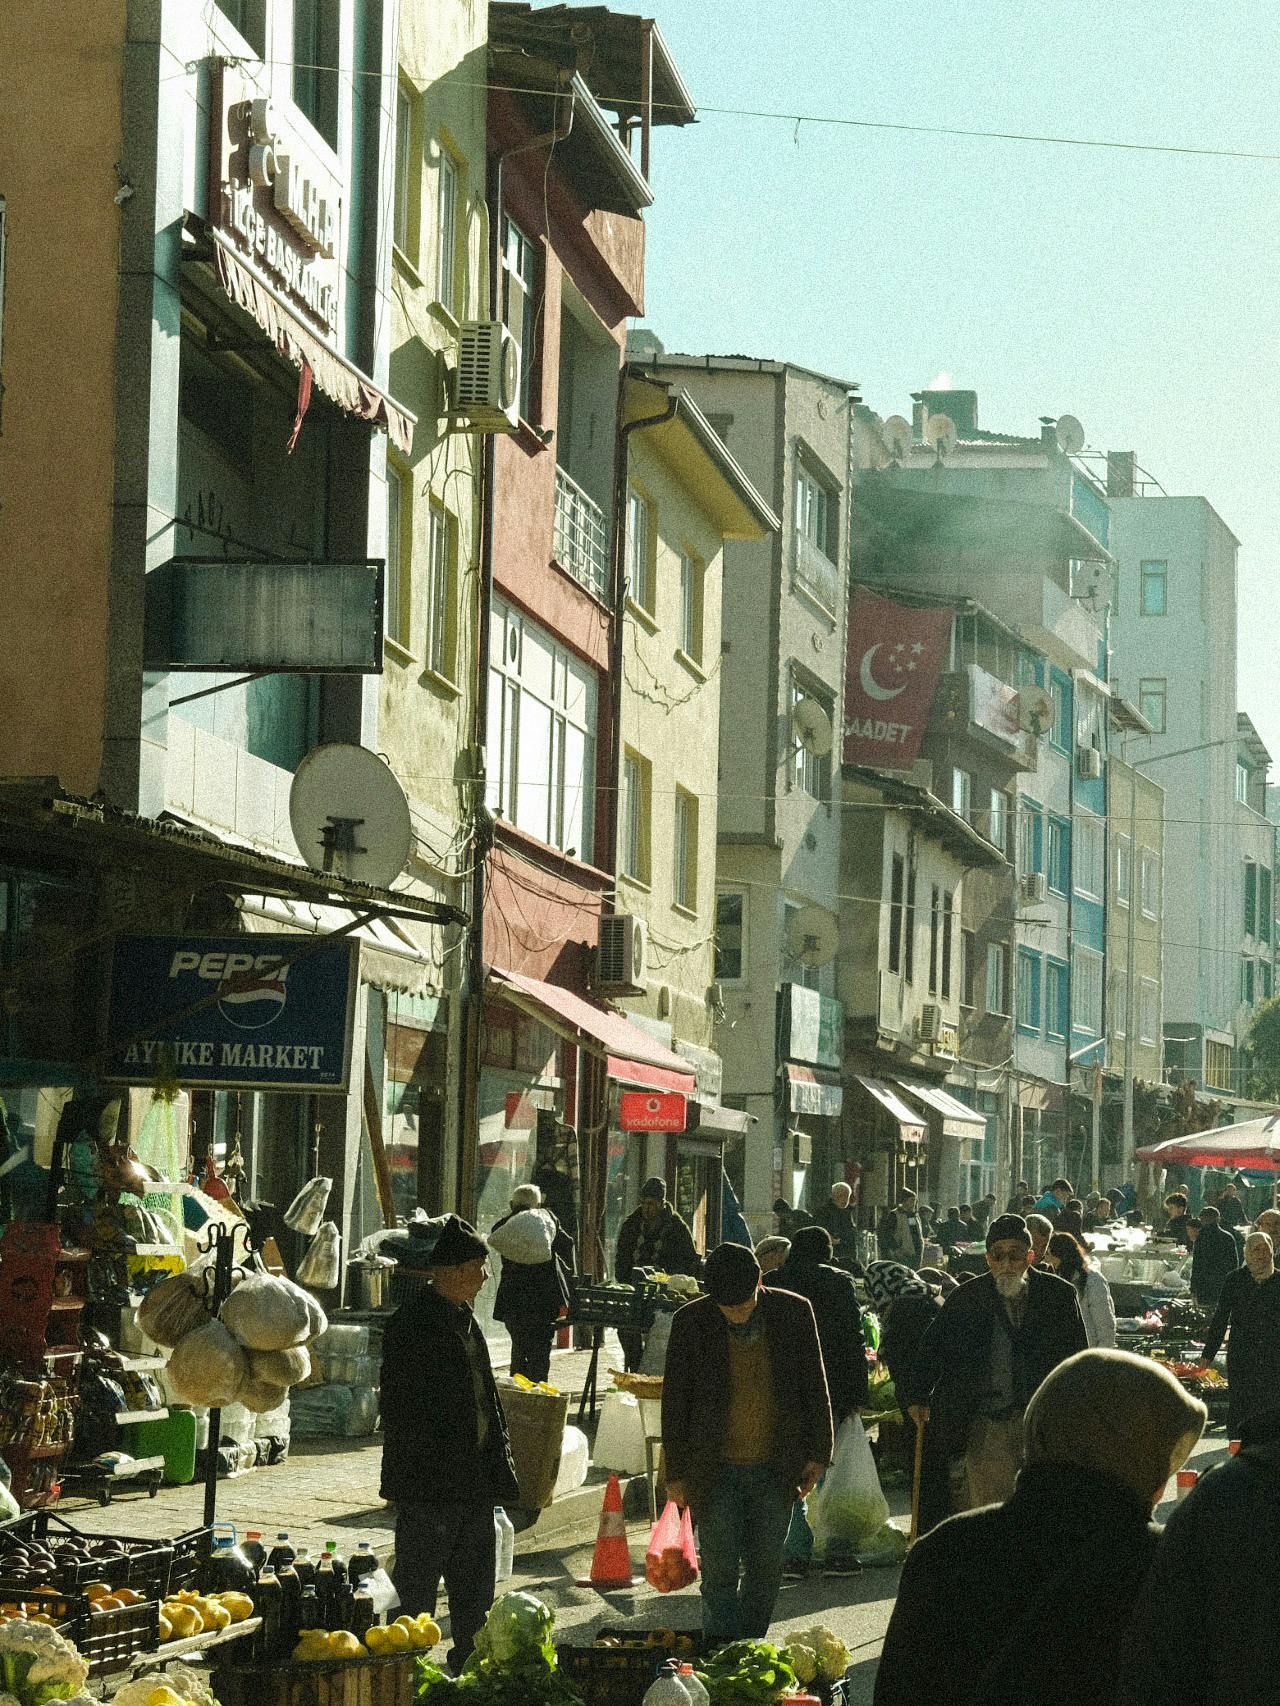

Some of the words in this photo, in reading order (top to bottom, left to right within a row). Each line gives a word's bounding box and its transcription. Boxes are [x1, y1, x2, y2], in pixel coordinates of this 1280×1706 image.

[168, 951, 290, 982] PEPSI
[124, 1036, 214, 1067] AYİKE
[220, 1043, 324, 1069] MARKET
[626, 1116, 680, 1127] vodafone
